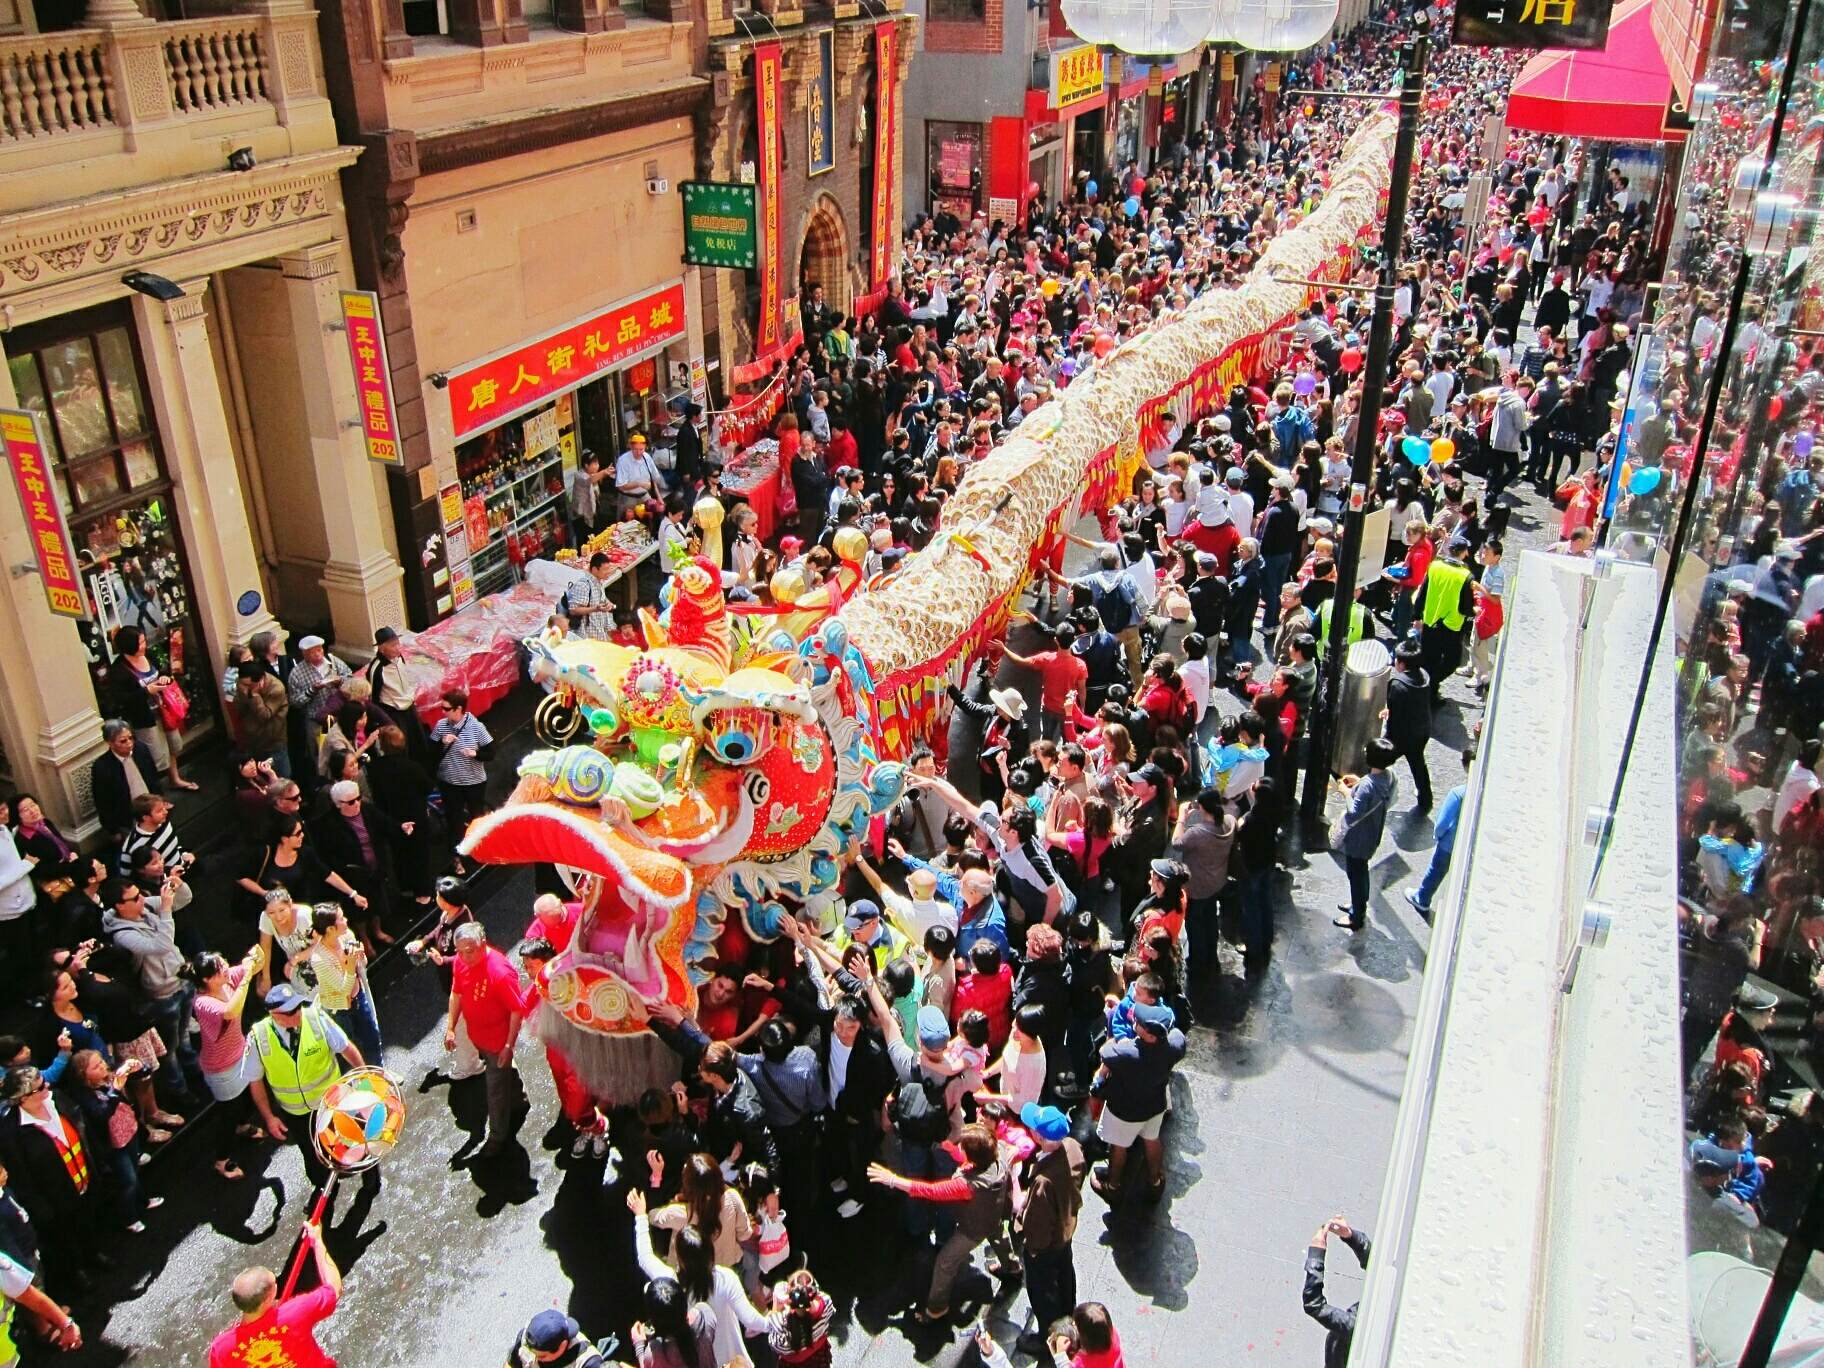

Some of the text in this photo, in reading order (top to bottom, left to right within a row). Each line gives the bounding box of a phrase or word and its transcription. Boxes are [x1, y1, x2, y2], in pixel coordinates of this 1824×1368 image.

[468, 302, 674, 412] 唐人街礼品城
[372, 442, 396, 457] 202
[54, 592, 81, 611] 202
[98, 572, 111, 605] UGG
